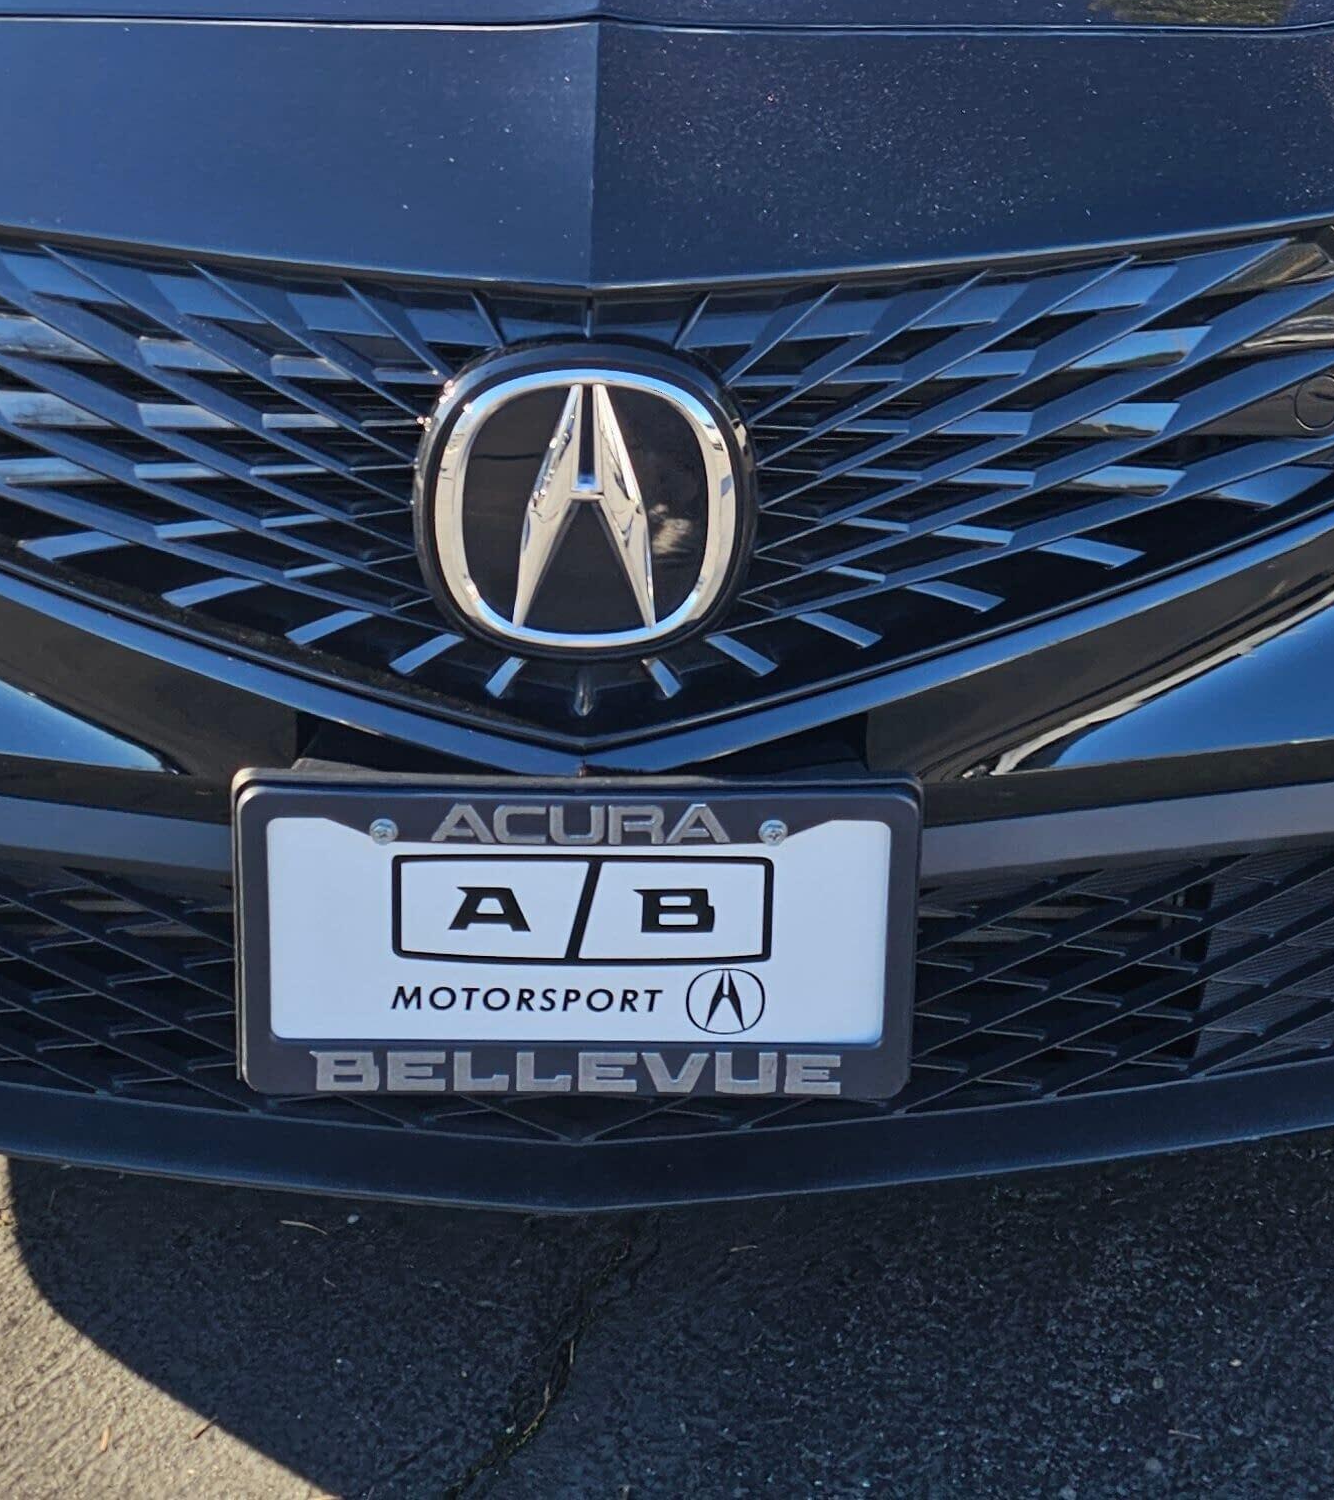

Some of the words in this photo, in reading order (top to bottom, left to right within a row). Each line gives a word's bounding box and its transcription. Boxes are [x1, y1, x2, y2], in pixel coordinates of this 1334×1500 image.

[430, 802, 732, 846] ACURA
[447, 886, 532, 933] A
[633, 887, 716, 934] B
[390, 984, 664, 1014] MOTORSPORT
[309, 1049, 842, 1096] BELLEVUE
